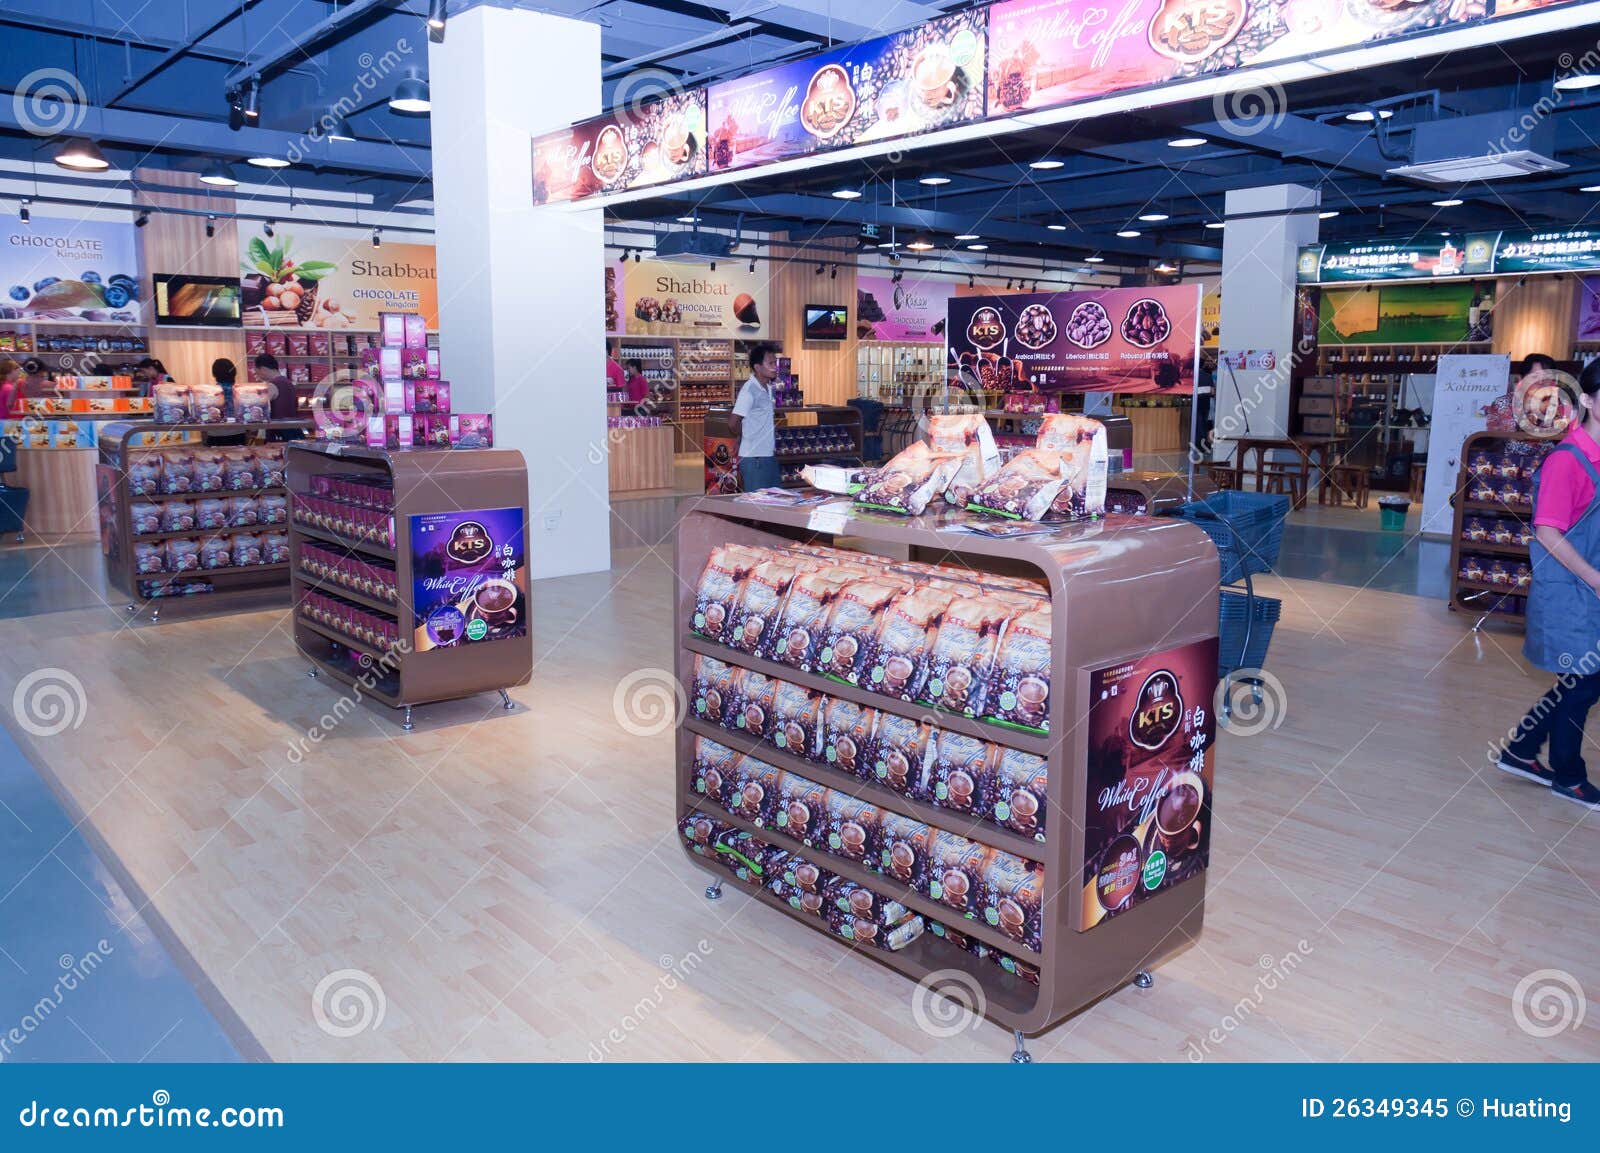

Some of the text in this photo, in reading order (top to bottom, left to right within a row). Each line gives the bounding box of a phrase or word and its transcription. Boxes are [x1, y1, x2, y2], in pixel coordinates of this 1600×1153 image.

[1073, 0, 1145, 68] Coffee
[757, 85, 799, 139] Coffee
[9, 235, 103, 250] CHOCOLATE
[57, 249, 103, 260] Kingdom
[352, 260, 437, 279] Shabbat
[657, 277, 728, 295] Shabbat
[353, 289, 419, 300] CHOCOLATE
[385, 301, 418, 309] Kingdom
[678, 304, 722, 312] CHOCOLATE
[972, 324, 999, 335] KTS
[454, 539, 484, 551] KTS
[502, 544, 516, 582] 白咖啡
[424, 576, 452, 591] White
[1139, 702, 1174, 728] KTS
[1190, 705, 1206, 773] 白咖啡
[1098, 767, 1169, 825] White Coffee
